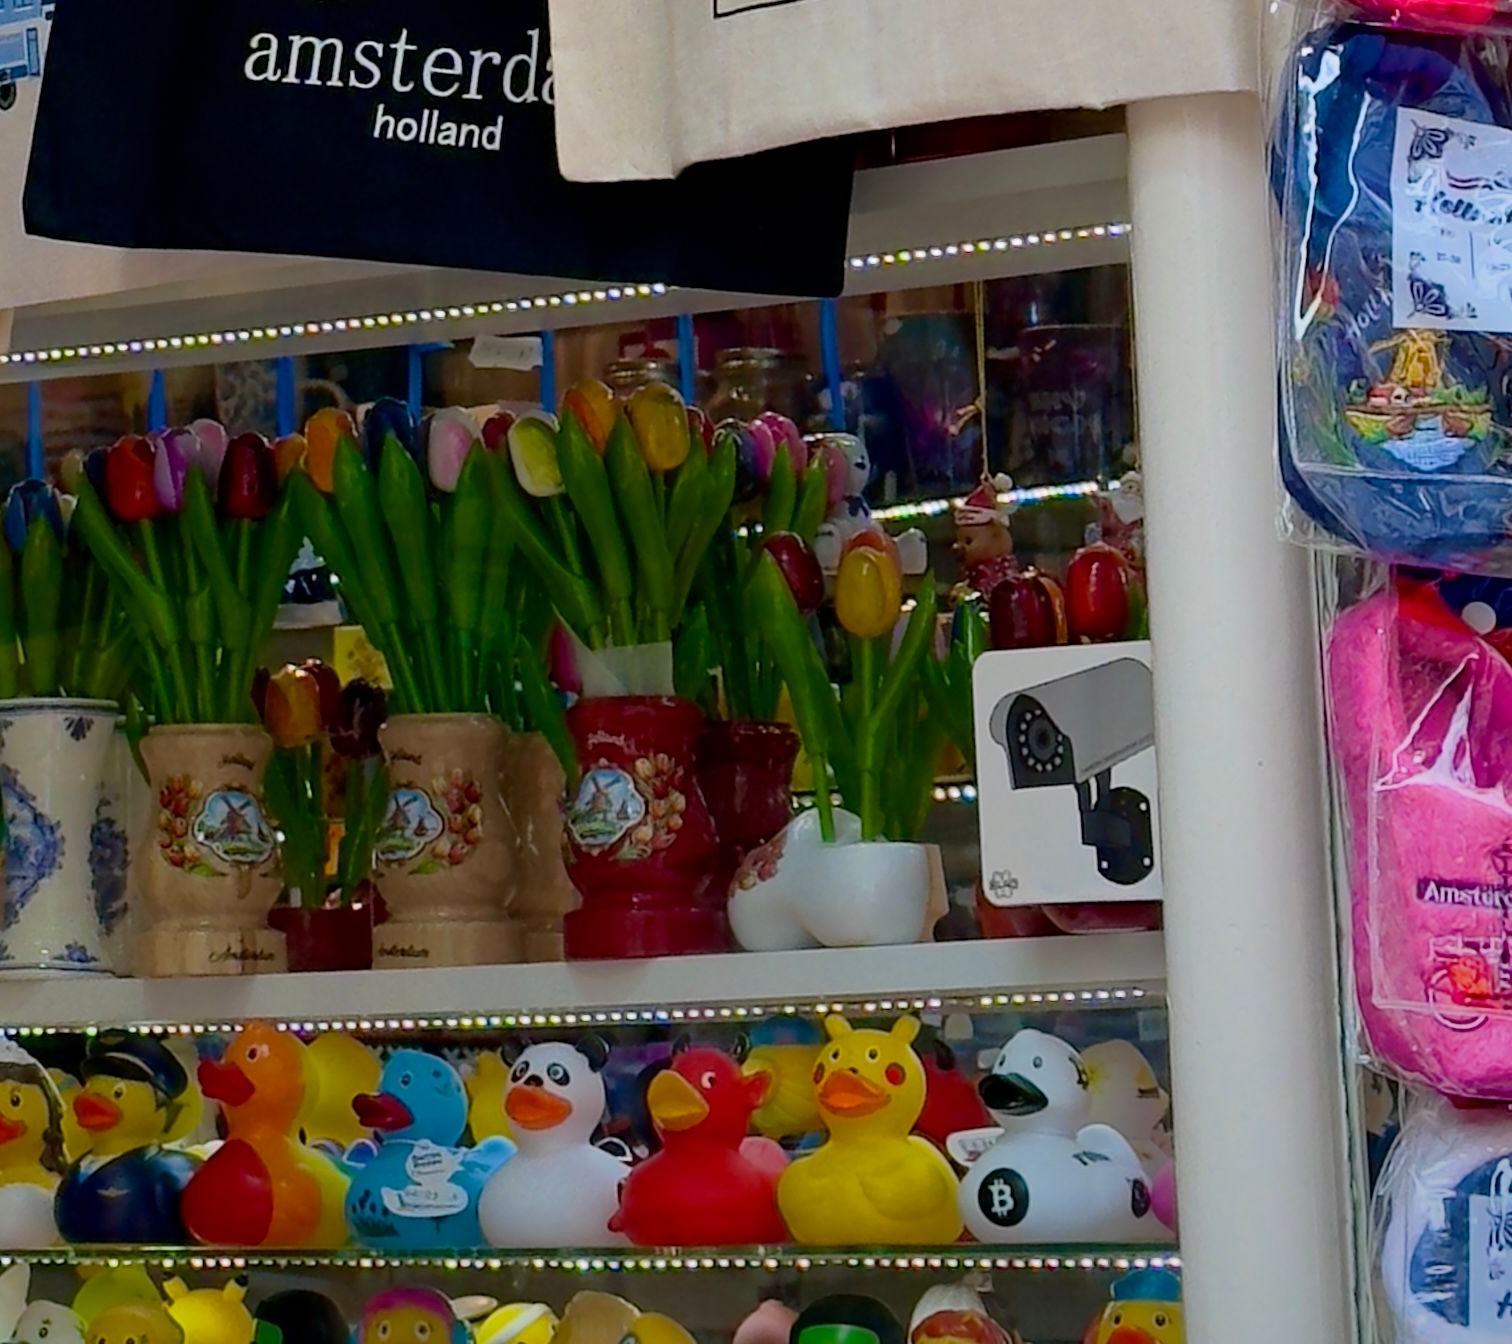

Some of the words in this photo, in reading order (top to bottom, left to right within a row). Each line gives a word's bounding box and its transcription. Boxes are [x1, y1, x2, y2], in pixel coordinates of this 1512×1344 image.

[244, 28, 554, 103] amsterd
[370, 109, 506, 153] holland
[1425, 879, 1512, 909] Amster
